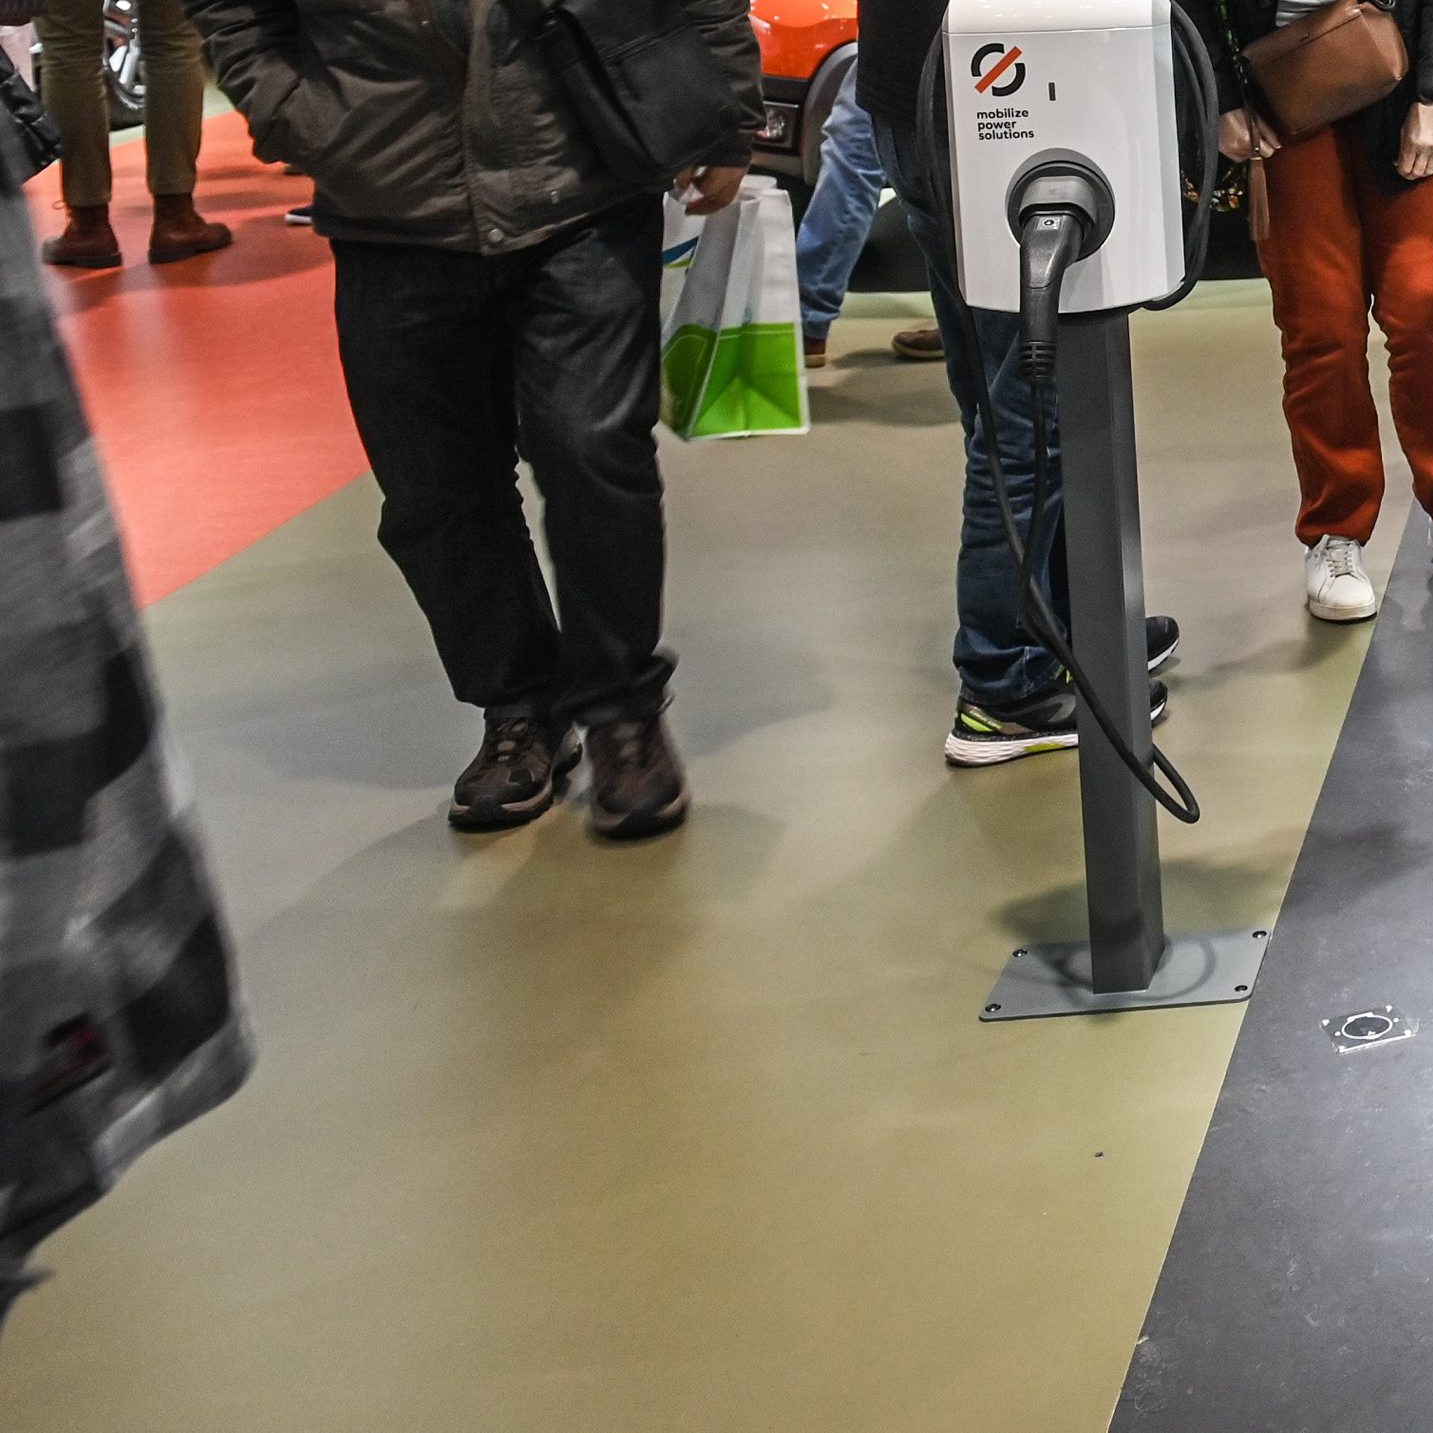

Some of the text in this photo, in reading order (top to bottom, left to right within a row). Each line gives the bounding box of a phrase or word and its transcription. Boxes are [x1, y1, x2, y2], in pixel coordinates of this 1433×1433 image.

[977, 108, 1029, 119] mobilize
[978, 121, 1017, 132] power
[978, 129, 1034, 140] solutions
